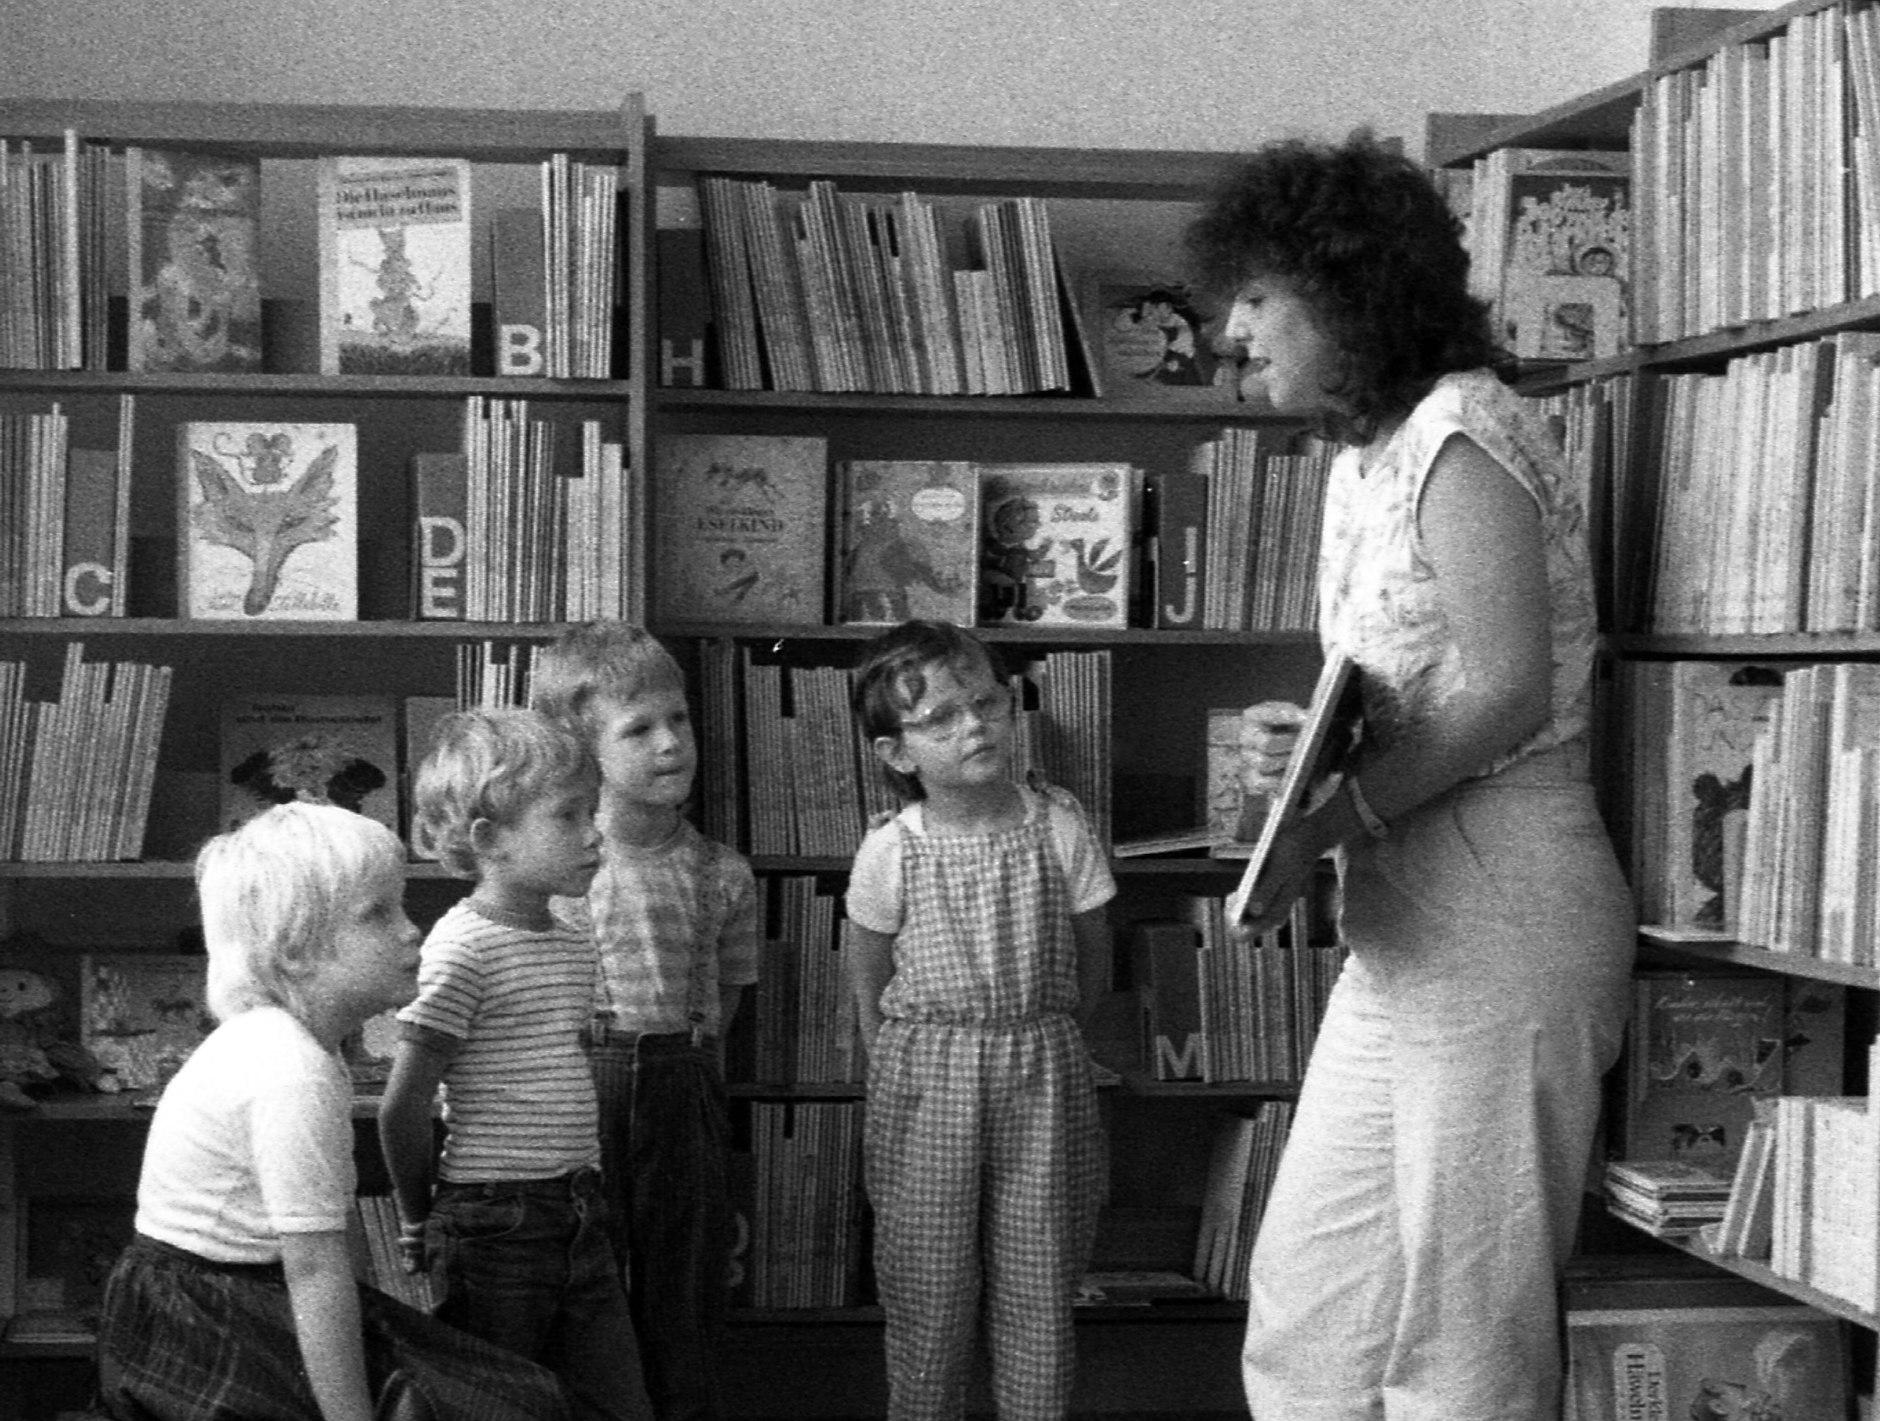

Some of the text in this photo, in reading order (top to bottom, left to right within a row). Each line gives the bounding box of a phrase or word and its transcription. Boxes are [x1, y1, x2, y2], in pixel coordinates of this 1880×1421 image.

[336, 186, 456, 204] Die Haselmaus
[501, 324, 543, 376] B
[661, 339, 704, 386] H
[420, 517, 465, 567] D
[65, 562, 111, 615] C
[422, 568, 458, 617] E
[1165, 527, 1197, 623] J
[1156, 1033, 1203, 1080] M
[1647, 1371, 1662, 1399] Der
